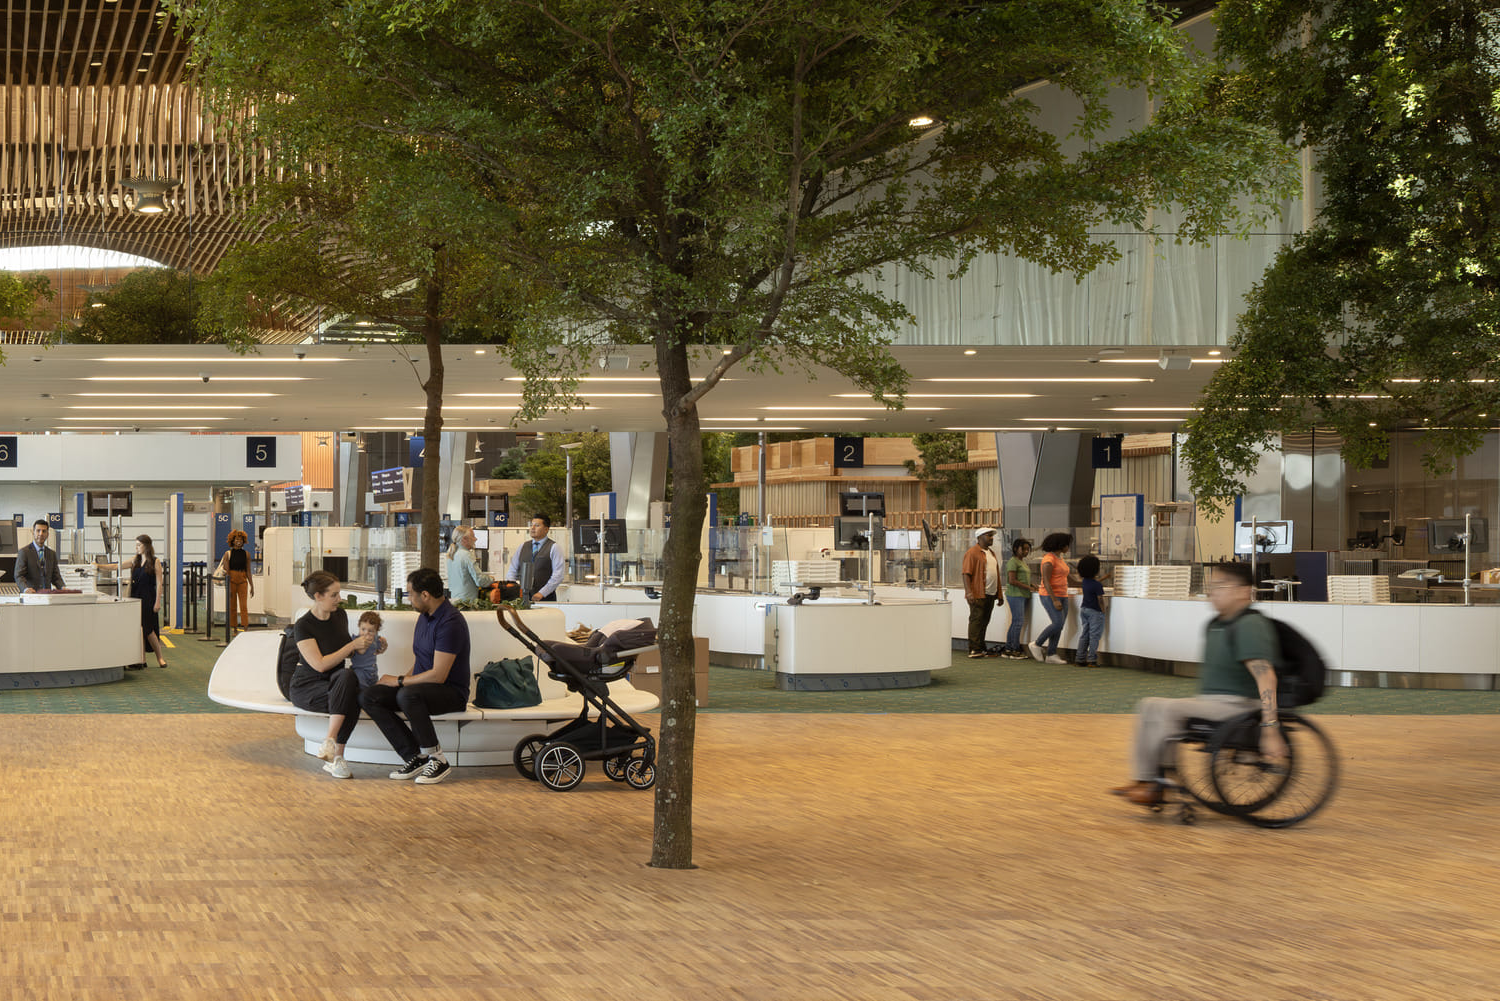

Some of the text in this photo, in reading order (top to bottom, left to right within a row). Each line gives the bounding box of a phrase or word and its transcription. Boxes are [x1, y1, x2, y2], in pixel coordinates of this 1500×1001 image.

[255, 444, 268, 462] 5
[843, 445, 855, 462] 2
[1103, 445, 1111, 462] 1
[50, 514, 61, 522] 6C
[218, 514, 229, 522] 5C
[494, 514, 506, 522] 4C
